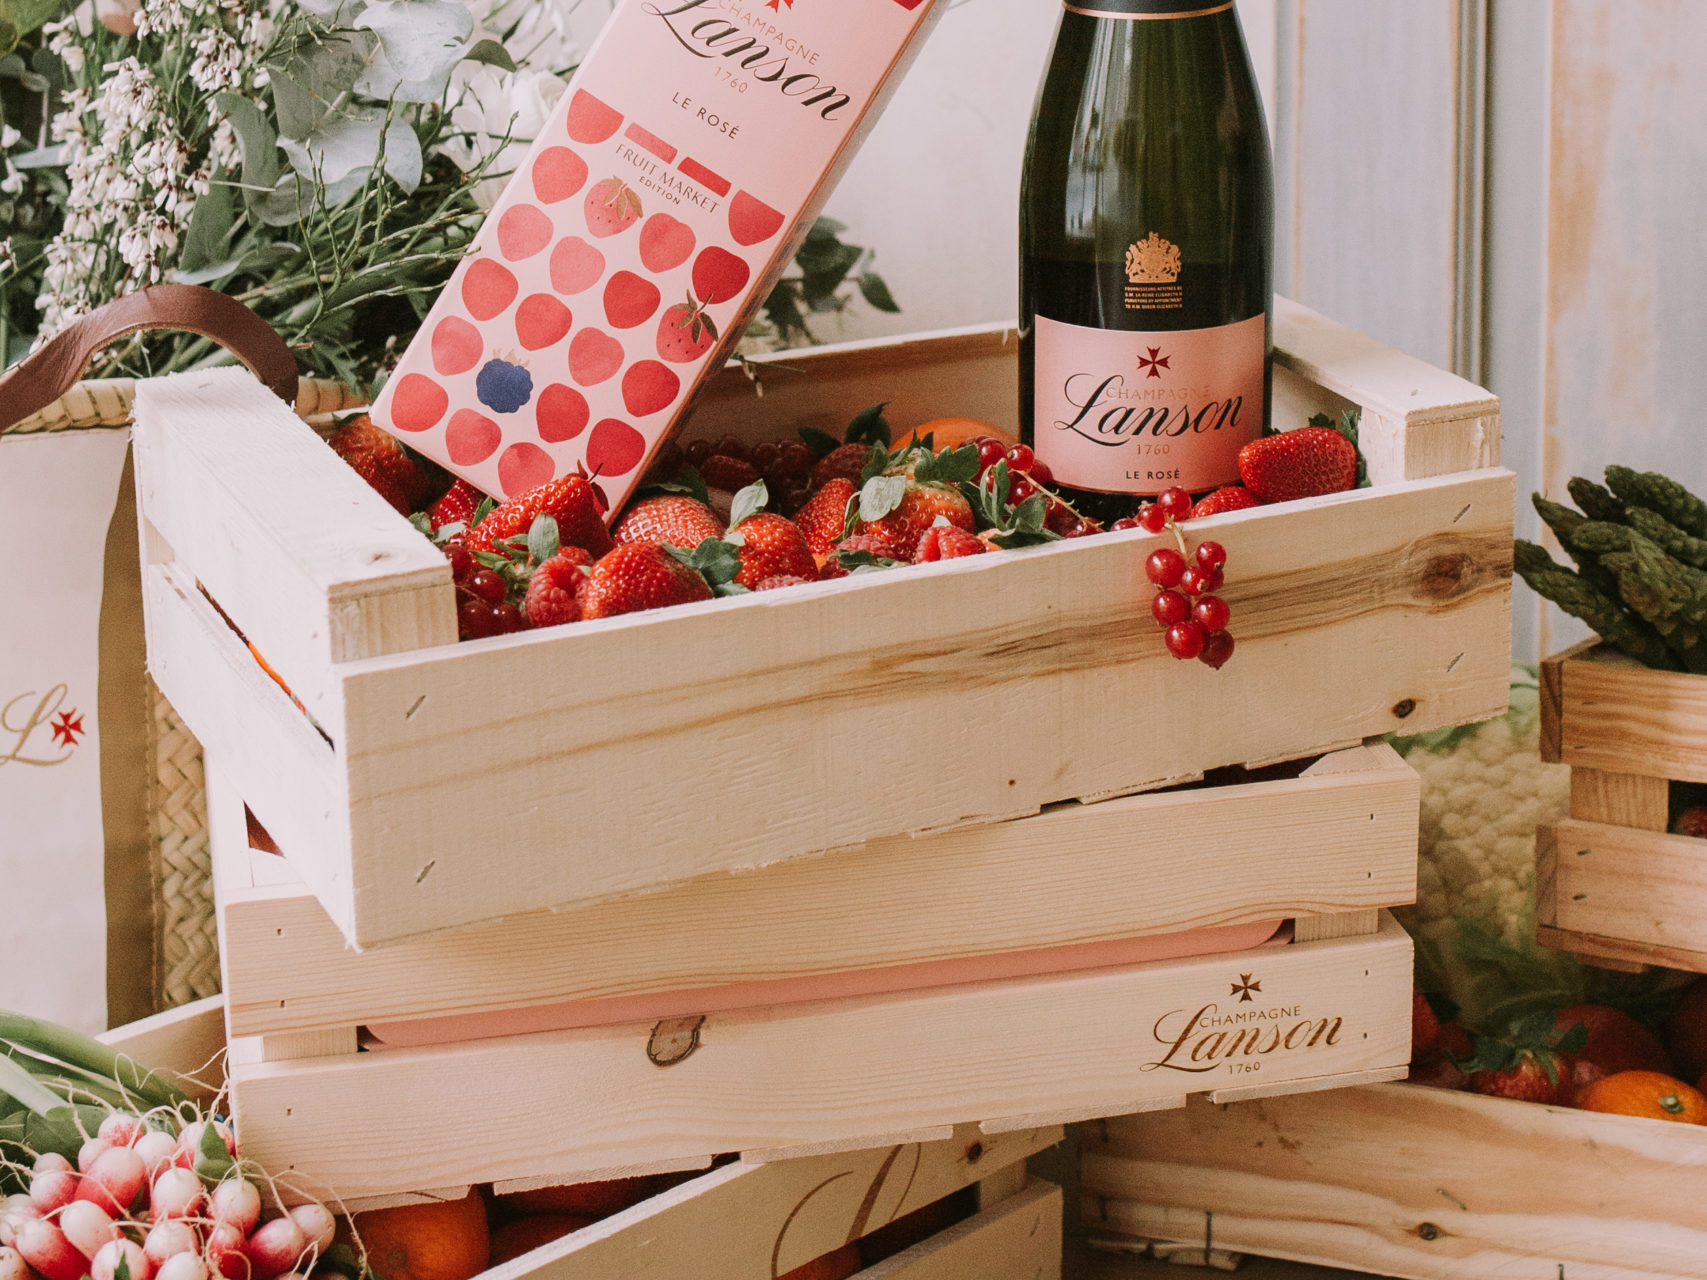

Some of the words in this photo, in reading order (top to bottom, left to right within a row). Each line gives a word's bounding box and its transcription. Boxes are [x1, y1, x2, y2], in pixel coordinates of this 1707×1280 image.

[714, 66, 748, 94] 1760
[672, 91, 692, 110] LE
[696, 106, 740, 140] ROSÉ
[615, 143, 659, 176] FRUIT
[658, 171, 720, 214] MARKET
[639, 176, 681, 206] EDITION
[1105, 384, 1211, 401] CHAMPAGNE
[1053, 372, 1244, 447] Lanson
[1136, 443, 1171, 456] 1760
[1126, 470, 1140, 480] LE
[1147, 468, 1181, 480] ROSÉ
[1199, 1005, 1302, 1029] CHAMPAGNE
[1139, 1003, 1343, 1073] Lanson
[1228, 1061, 1261, 1075] 1760
